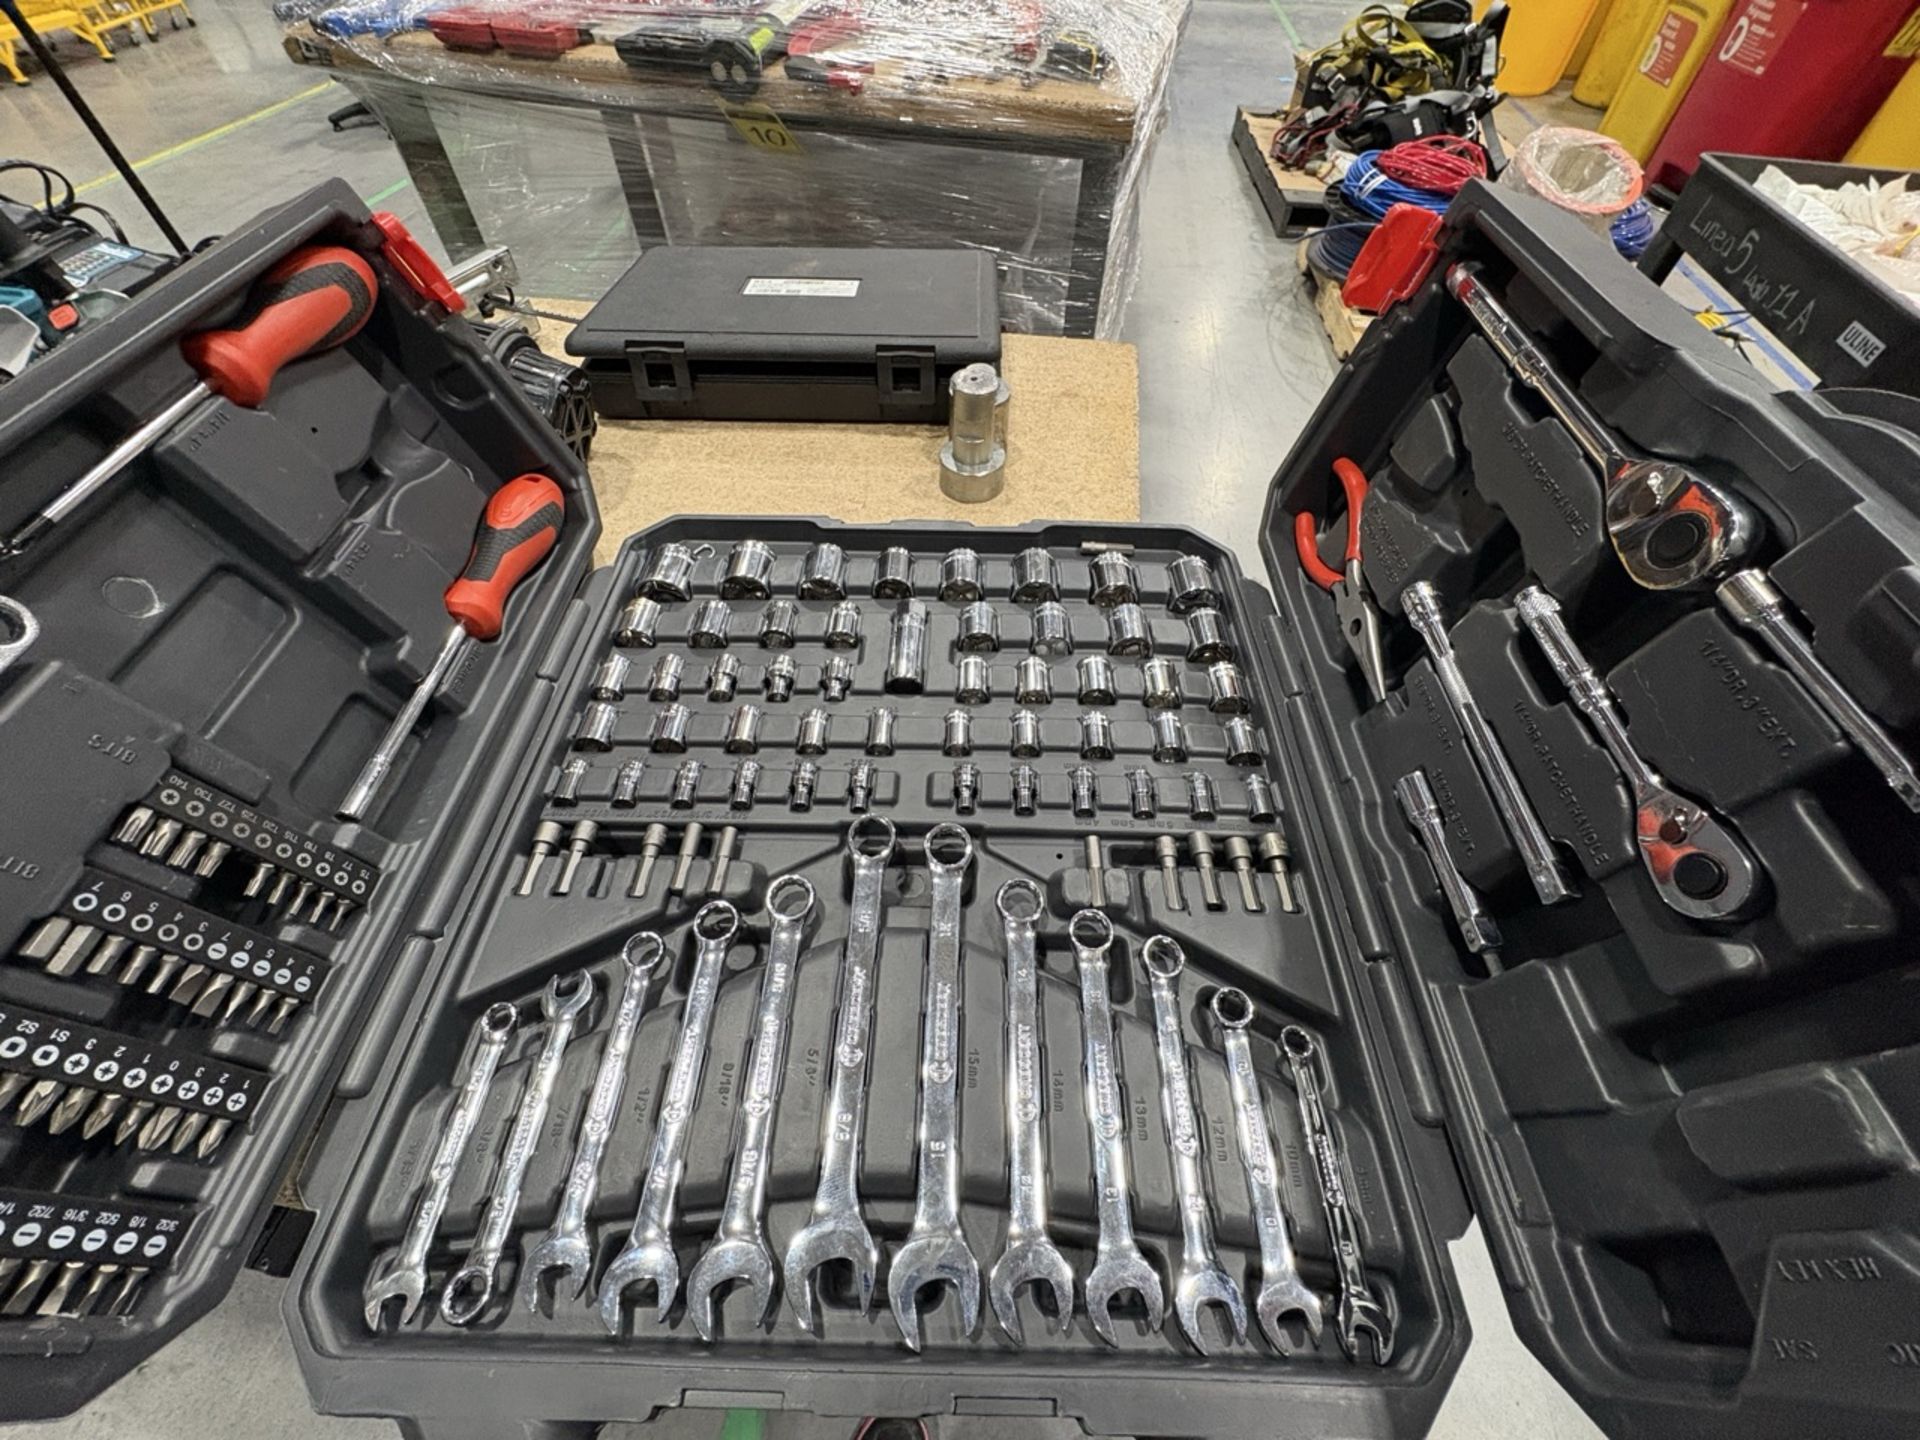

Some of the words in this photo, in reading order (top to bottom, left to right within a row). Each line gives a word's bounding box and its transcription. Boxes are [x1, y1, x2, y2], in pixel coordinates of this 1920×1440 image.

[749, 126, 787, 147] 10
[1689, 195, 1735, 258] Linea
[1724, 228, 1761, 274] 5
[1785, 298, 1817, 336] A
[1842, 324, 1880, 362] ULINE
[87, 733, 138, 765] BITS
[168, 774, 189, 791] T40
[193, 786, 213, 802] T30
[217, 799, 236, 814] T27
[262, 820, 279, 834] T20
[91, 881, 104, 892] 7
[120, 891, 132, 903] 6
[148, 902, 159, 913] 5
[173, 911, 184, 922] 4
[198, 921, 209, 932] 3
[221, 931, 232, 942] 7
[244, 940, 254, 951] 6
[265, 949, 276, 959] 5
[285, 957, 295, 967] 4
[306, 965, 316, 975] 3
[16, 1019, 40, 1035] S2
[49, 1028, 71, 1043] S1
[85, 1038, 97, 1050] 3
[113, 1046, 128, 1058] 2
[169, 1060, 180, 1071] 0
[966, 1048, 981, 1090] 15mm
[195, 1066, 206, 1078] 3
[219, 1073, 231, 1084] 2
[1134, 1095, 1149, 1143] 13mm
[1211, 1116, 1228, 1163] 12mm
[27, 1204, 56, 1219] 7/32
